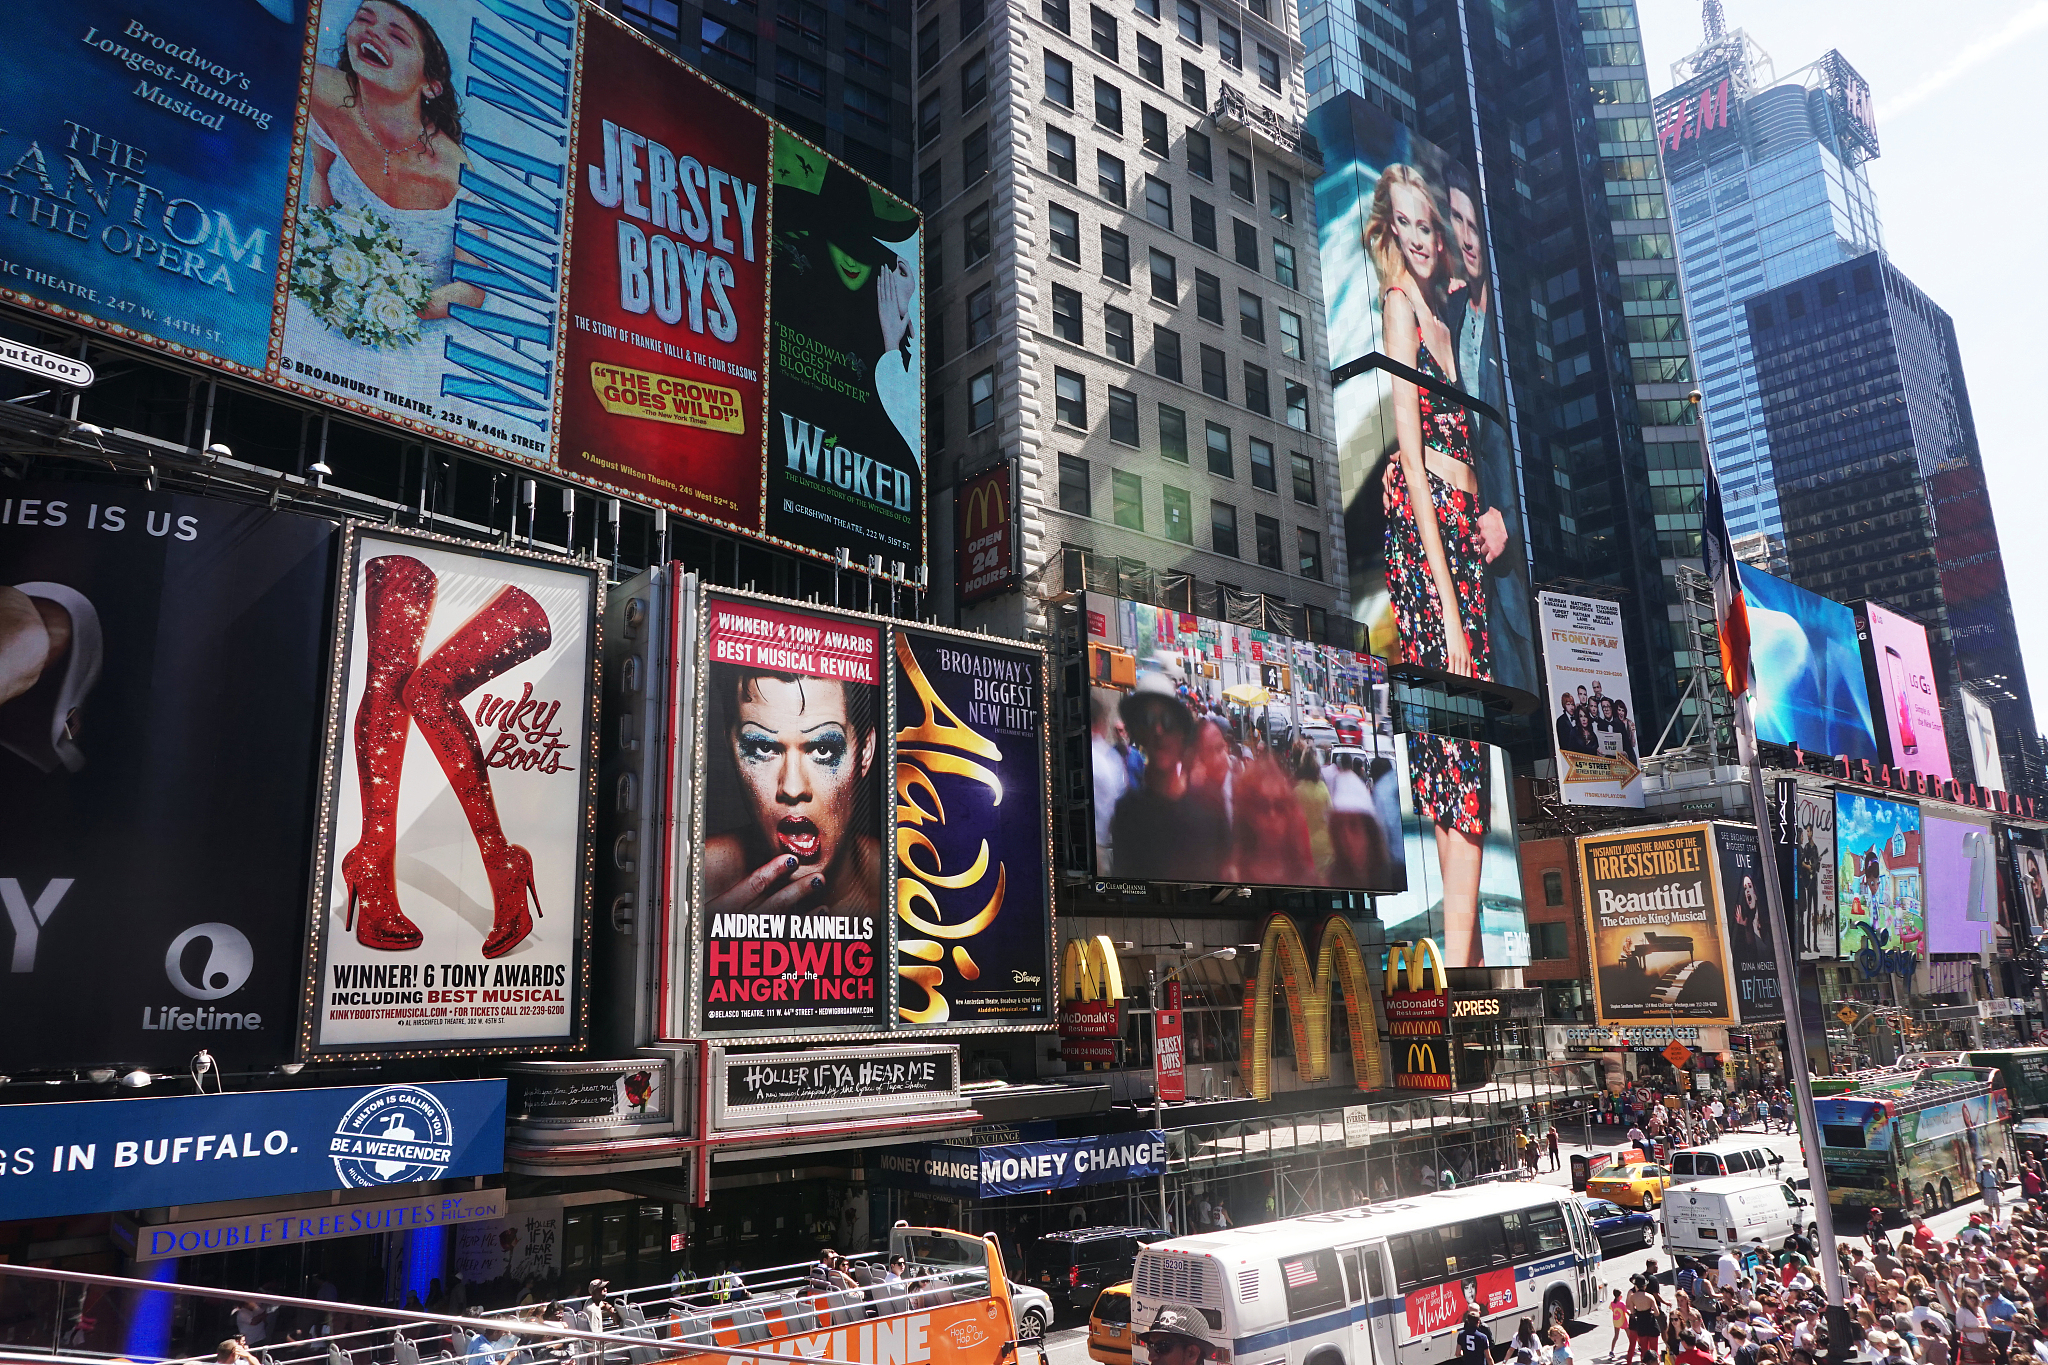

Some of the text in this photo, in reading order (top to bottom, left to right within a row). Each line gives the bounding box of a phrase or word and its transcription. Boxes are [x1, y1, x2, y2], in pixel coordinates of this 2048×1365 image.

[124, 19, 251, 91] Broadway's
[81, 26, 273, 131] Longest-Running
[132, 79, 222, 131] Musical
[1659, 79, 1728, 154] H&M
[63, 119, 148, 176] THE
[0, 129, 271, 274] ANTOM
[588, 118, 757, 262] JERSEY
[0, 184, 236, 295] THE OPERA
[440, 132, 568, 432] MAMMA
[617, 219, 738, 344] BOYS
[574, 314, 757, 382] THE STORY OF FRANKIE VALLI & THE FOUR SEASONS
[780, 338, 832, 373] BIGGEST
[604, 386, 666, 410] GOES
[656, 378, 734, 407] CROWD
[295, 361, 380, 399] BROADHURST
[383, 388, 437, 421] THEATRE,
[441, 409, 463, 426] 235
[510, 432, 546, 454] STREET
[87, 503, 126, 532] IS
[146, 510, 199, 542] US
[968, 530, 1002, 554] OPEN
[972, 546, 999, 574] 24
[965, 566, 1008, 593] HOURS
[719, 612, 873, 653] WINNER! 4 TONY AWARDS
[1568, 634, 1590, 646] ONLY
[1590, 637, 1597, 646] A
[781, 641, 815, 653] INCLUDING
[717, 640, 873, 681] BEST MUSICAL REVIVAL
[974, 679, 1033, 708] BIGGEST
[968, 701, 1000, 726] NEW
[484, 732, 576, 775] Boots
[1843, 754, 2034, 818] 1540 BROADWAY
[1623, 844, 1640, 854] JOINS
[1641, 842, 1652, 852] THE
[1654, 840, 1674, 851] RANKS
[1677, 839, 1684, 849] OF
[1685, 837, 1697, 849] THE
[1726, 842, 1757, 852] BIGGEST STAR
[1735, 854, 1752, 868] LIVE
[1598, 881, 1704, 914] Beautiful
[711, 913, 873, 940] ANDREW RANNELLS
[1601, 910, 1706, 927] The Carole King Musical
[709, 941, 874, 976] HEDWIG
[1757, 961, 1775, 970] MENZEL
[1851, 920, 1917, 994] Disney
[333, 963, 566, 989] WINNER! 6 TONY AWARDS
[781, 971, 818, 980] and the
[1011, 970, 1041, 986] Disney
[331, 989, 564, 1006] INCLUDING BEST MUSICAL
[708, 978, 874, 1003] ANGRY INCH
[1742, 975, 1781, 1003] IF/THEN
[330, 1005, 565, 1020] KINKYBOOTSTHEMUSICAL.COM FOR TICKETS CALL 212-239-6200
[1387, 998, 1444, 1010] McDonald's
[1452, 999, 1500, 1017] XPRESS
[142, 1005, 262, 1031] Lifetime
[1060, 1012, 1116, 1024] McDonald's
[1157, 1034, 1182, 1055] JERSEY
[1566, 1027, 1699, 1040] GIFTS LUGGAGE
[1062, 1047, 1112, 1056] OPEN 24 HOURS
[1161, 1052, 1180, 1070] BOYS
[744, 1062, 936, 1091] HOLLER IF YA HEAR ME
[352, 1095, 443, 1136] HILTON IS CALLING YOU
[52, 1144, 95, 1172] IN
[114, 1130, 298, 1168] BUFFALO.
[330, 1138, 451, 1163] BE A WEEKENDER
[981, 1143, 1165, 1184] MONEY CHANGE
[881, 1155, 979, 1181] MONEY CHANGE
[441, 1205, 497, 1220] HILTON
[442, 1198, 462, 1210] BY
[1165, 1259, 1183, 1270] 5230
[1417, 1297, 1457, 1334] Murder
[950, 1325, 978, 1338] Hop On
[956, 1331, 984, 1344] Hop Off
[1466, 1335, 1475, 1351] 5
